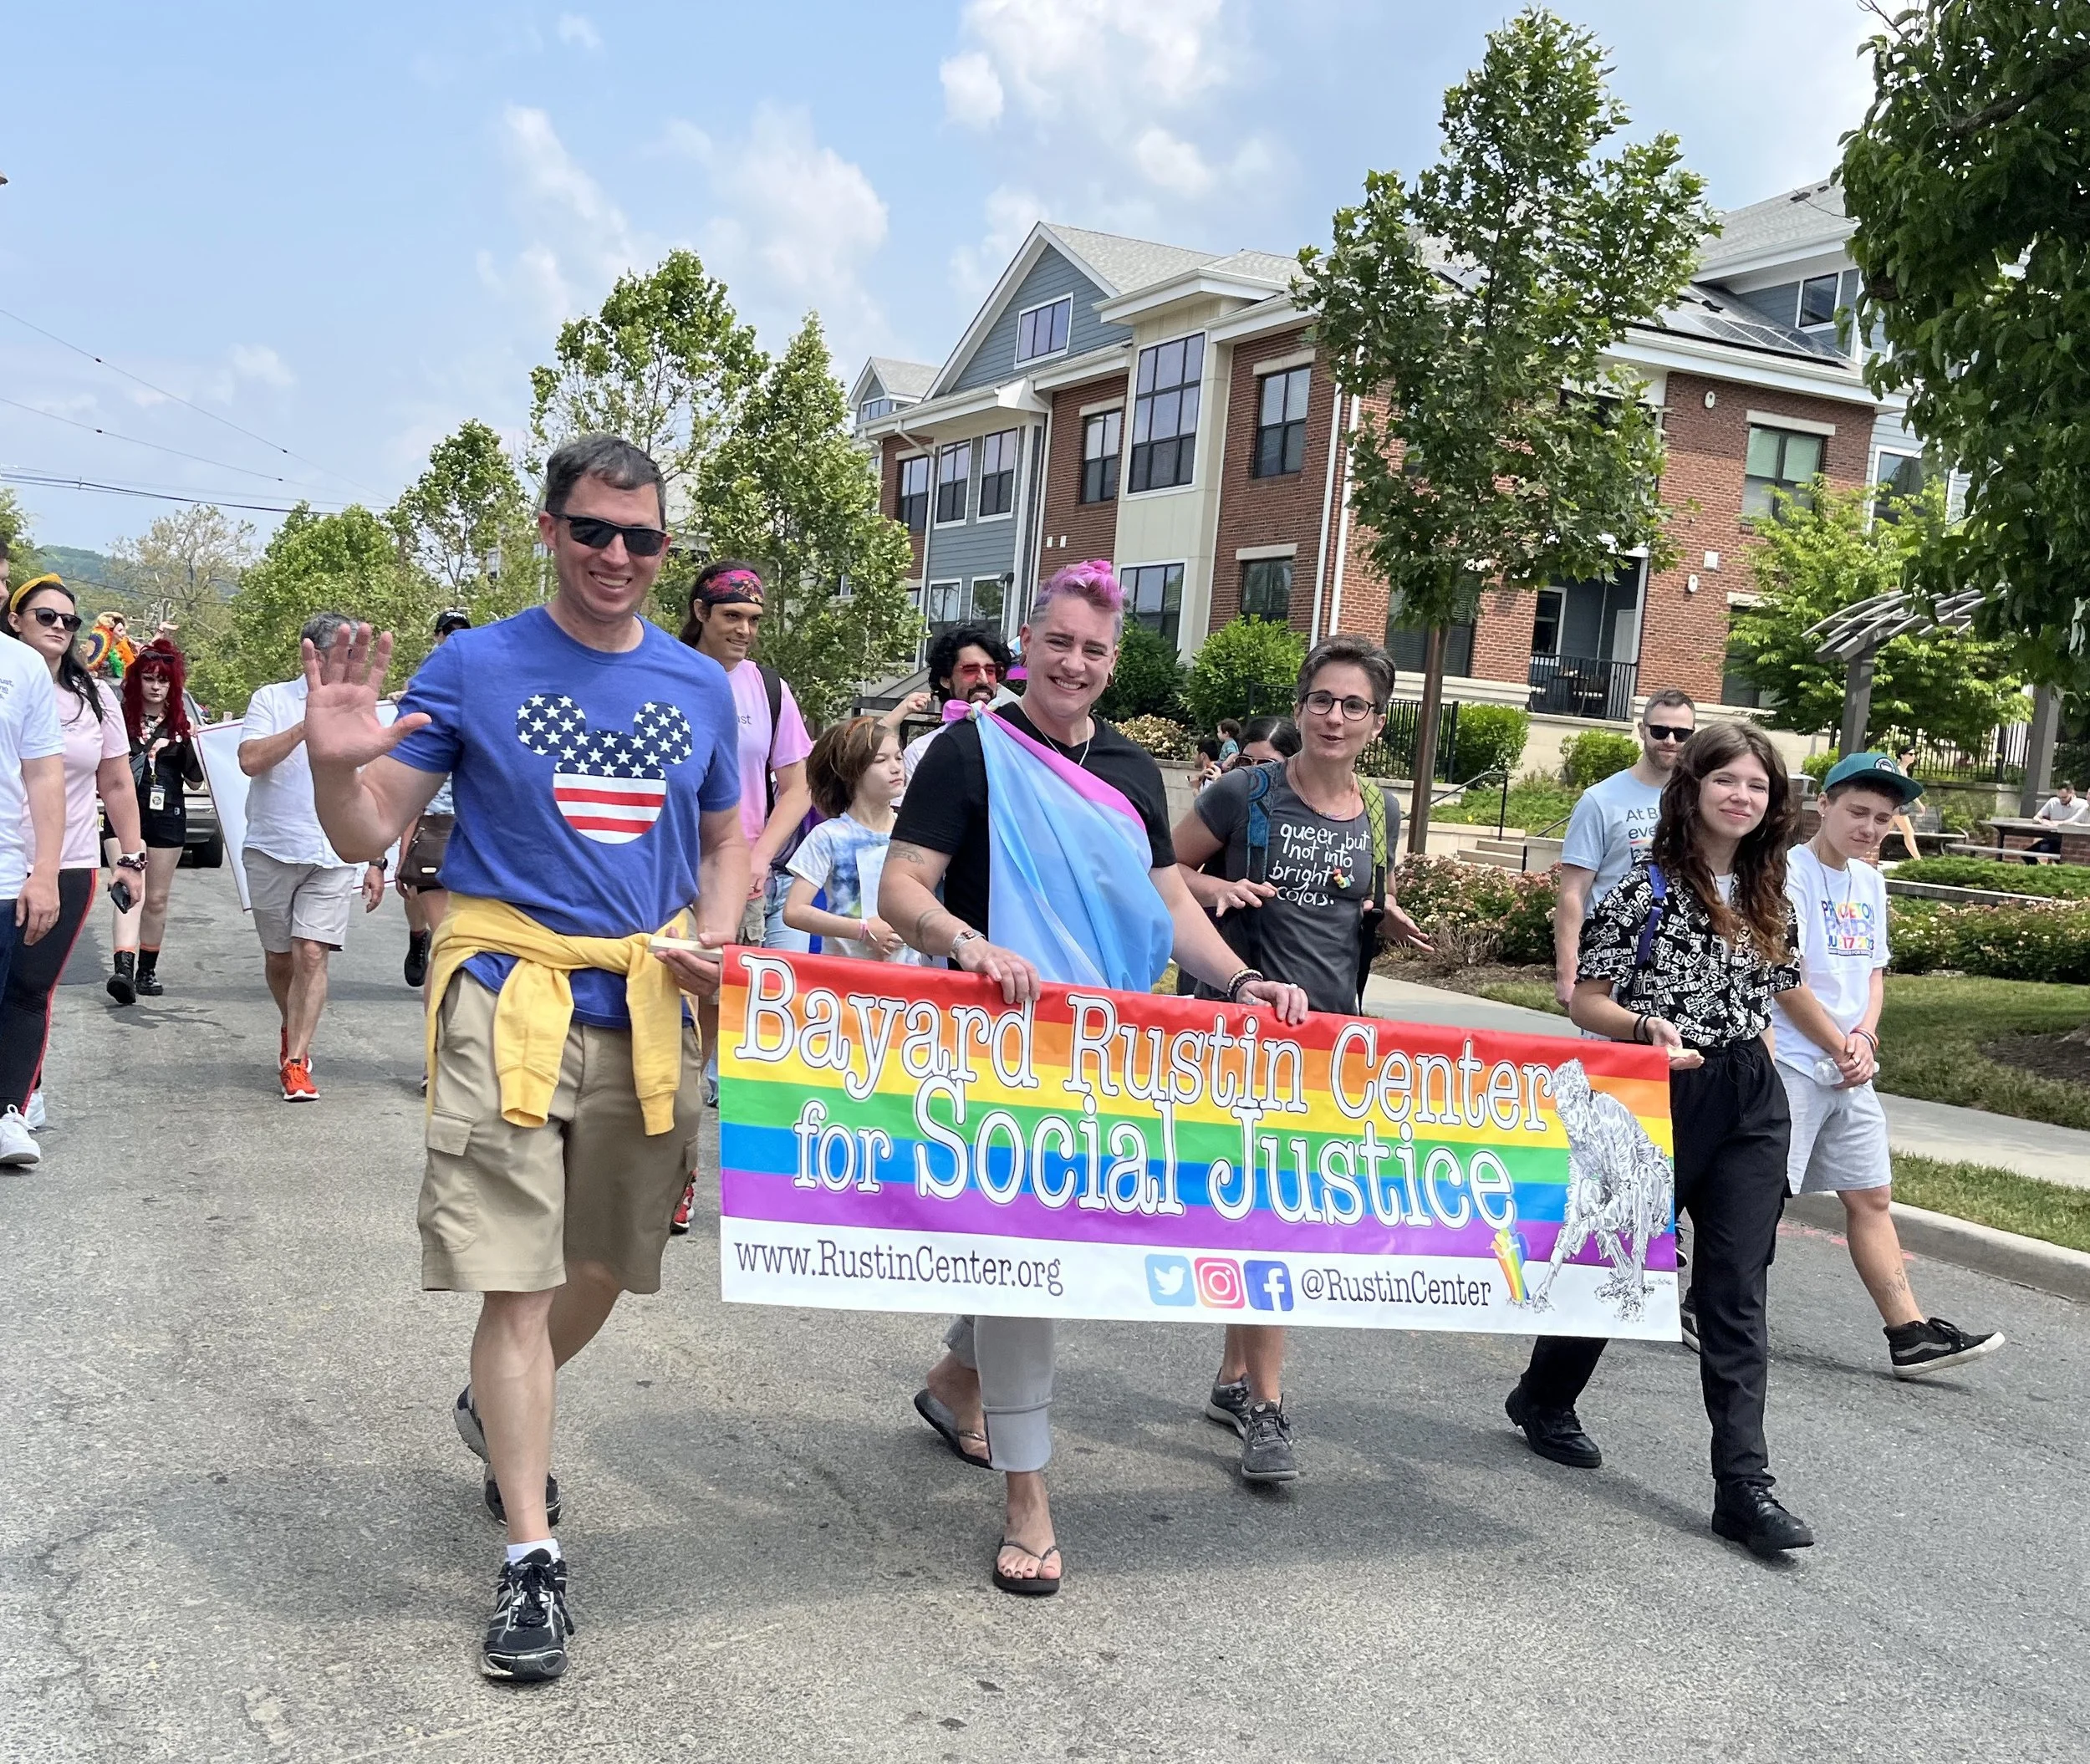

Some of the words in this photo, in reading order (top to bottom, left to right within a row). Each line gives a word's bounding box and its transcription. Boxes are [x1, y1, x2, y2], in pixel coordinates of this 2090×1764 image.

[737, 714, 752, 725] st
[1626, 808, 1645, 823] At
[1280, 823, 1338, 854] queer
[1346, 831, 1370, 851] but
[1288, 839, 1320, 862] not
[1325, 843, 1353, 869] into
[1268, 859, 1333, 891] bright
[1277, 884, 1334, 906] colors.
[1843, 936, 1855, 949] 17
[735, 954, 1039, 1100] Bayard
[1063, 994, 1308, 1114] Rustin
[1330, 1022, 1552, 1131] Center
[793, 1099, 892, 1193] for
[916, 1075, 1184, 1216] Social
[1207, 1105, 1515, 1230] Justice
[733, 1240, 1063, 1296] www.RustinCenter.org
[1301, 1268, 1491, 1308] @RustinCenter
